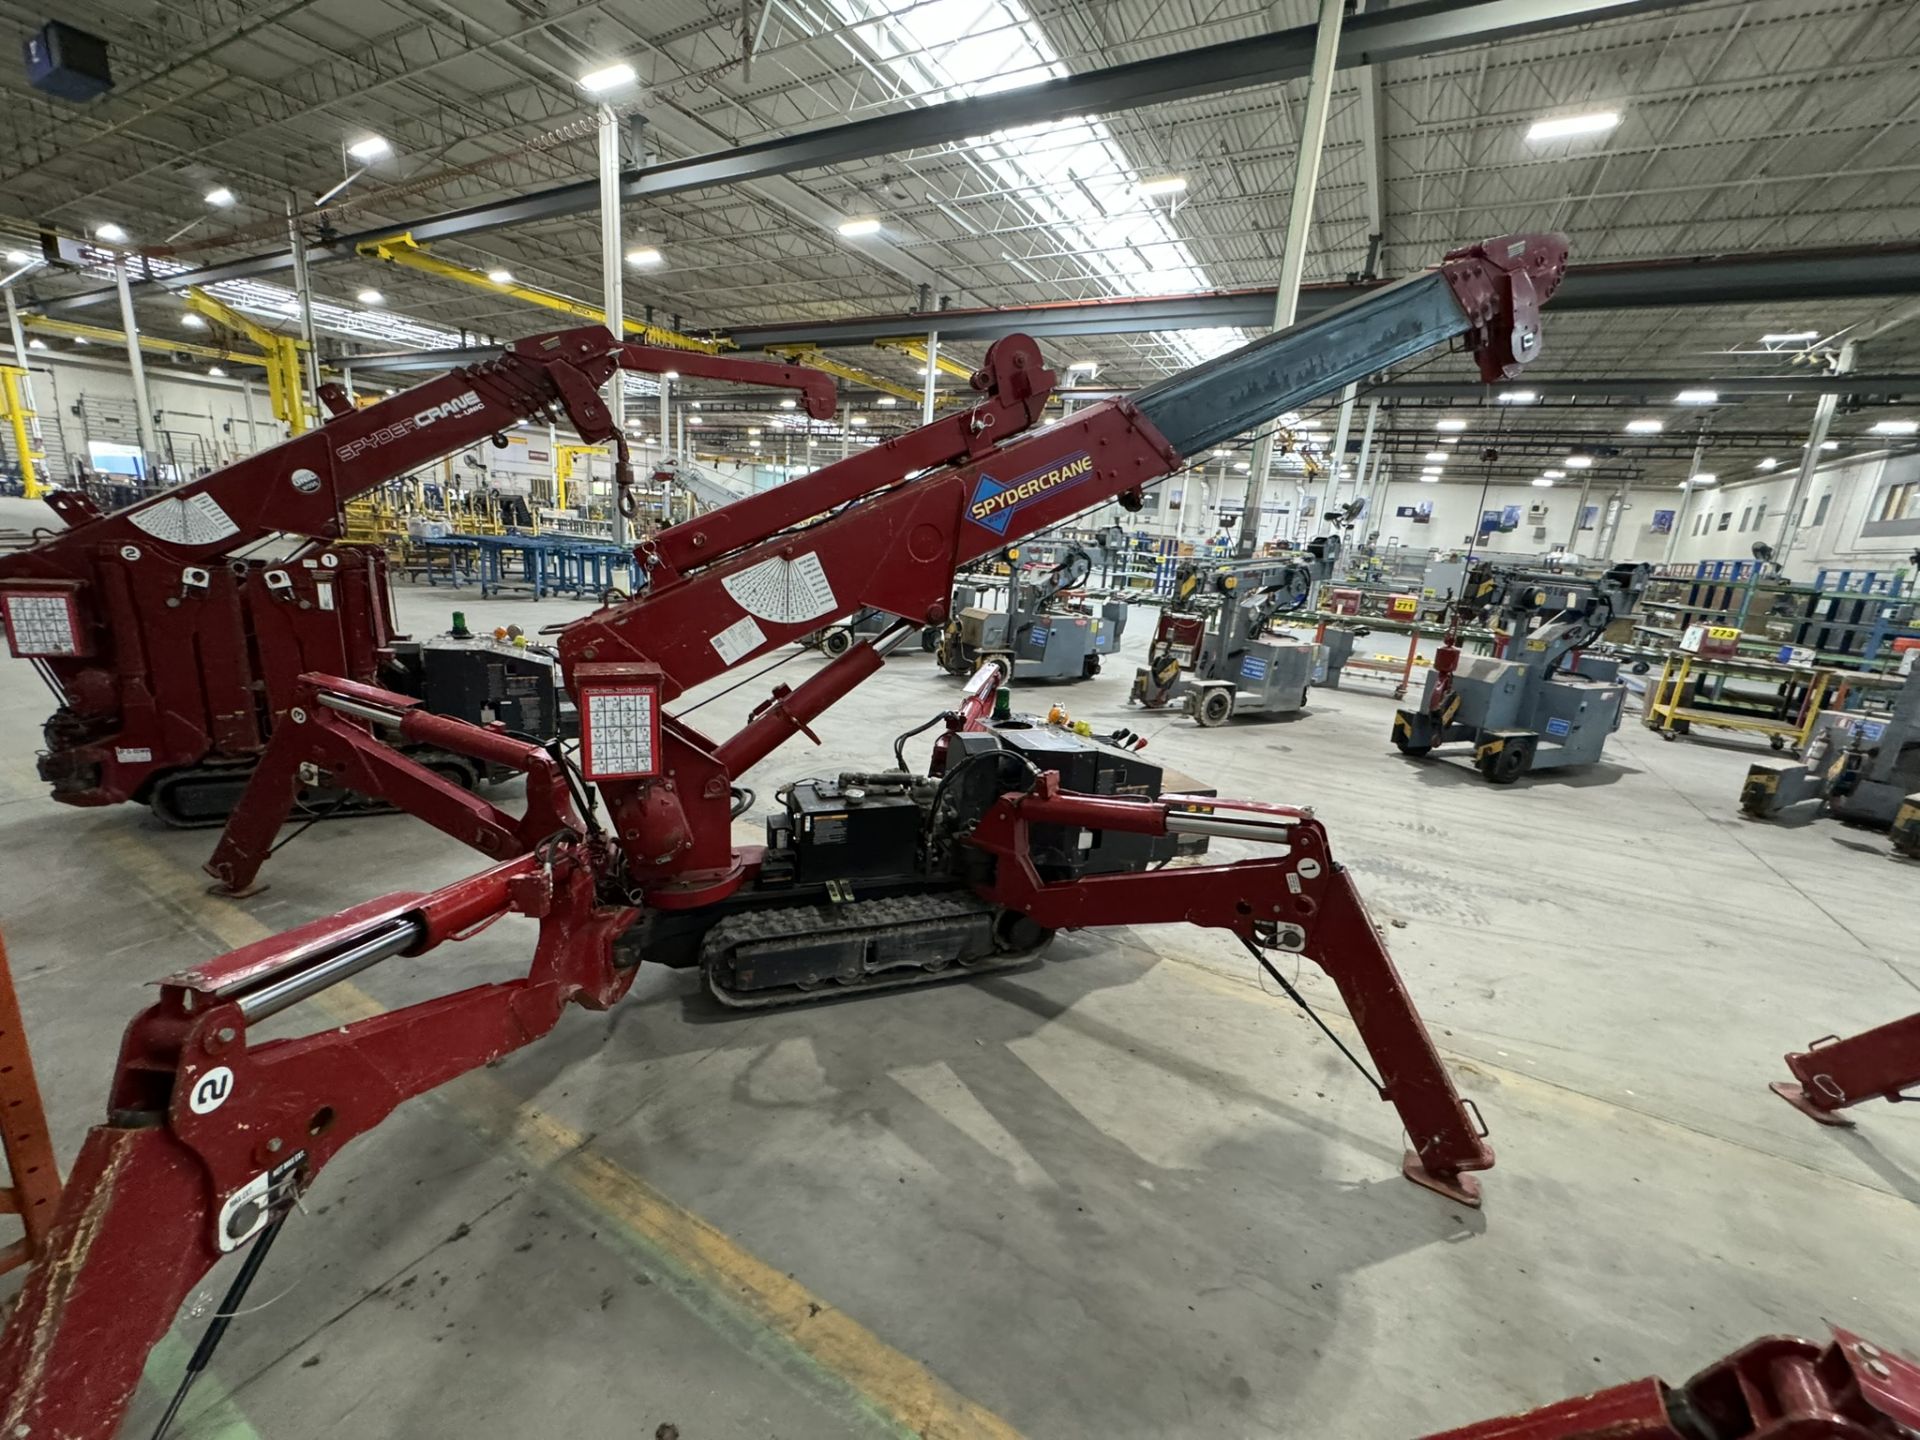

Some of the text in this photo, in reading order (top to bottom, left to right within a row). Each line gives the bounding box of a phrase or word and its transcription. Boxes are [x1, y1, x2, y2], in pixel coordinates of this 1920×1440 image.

[335, 390, 482, 462] SPYDERCRANE
[971, 456, 1093, 520] SPYDERCRANE
[125, 548, 138, 559] 2
[1712, 629, 1735, 637] 773
[293, 710, 304, 721] 3
[198, 1074, 228, 1105] 2
